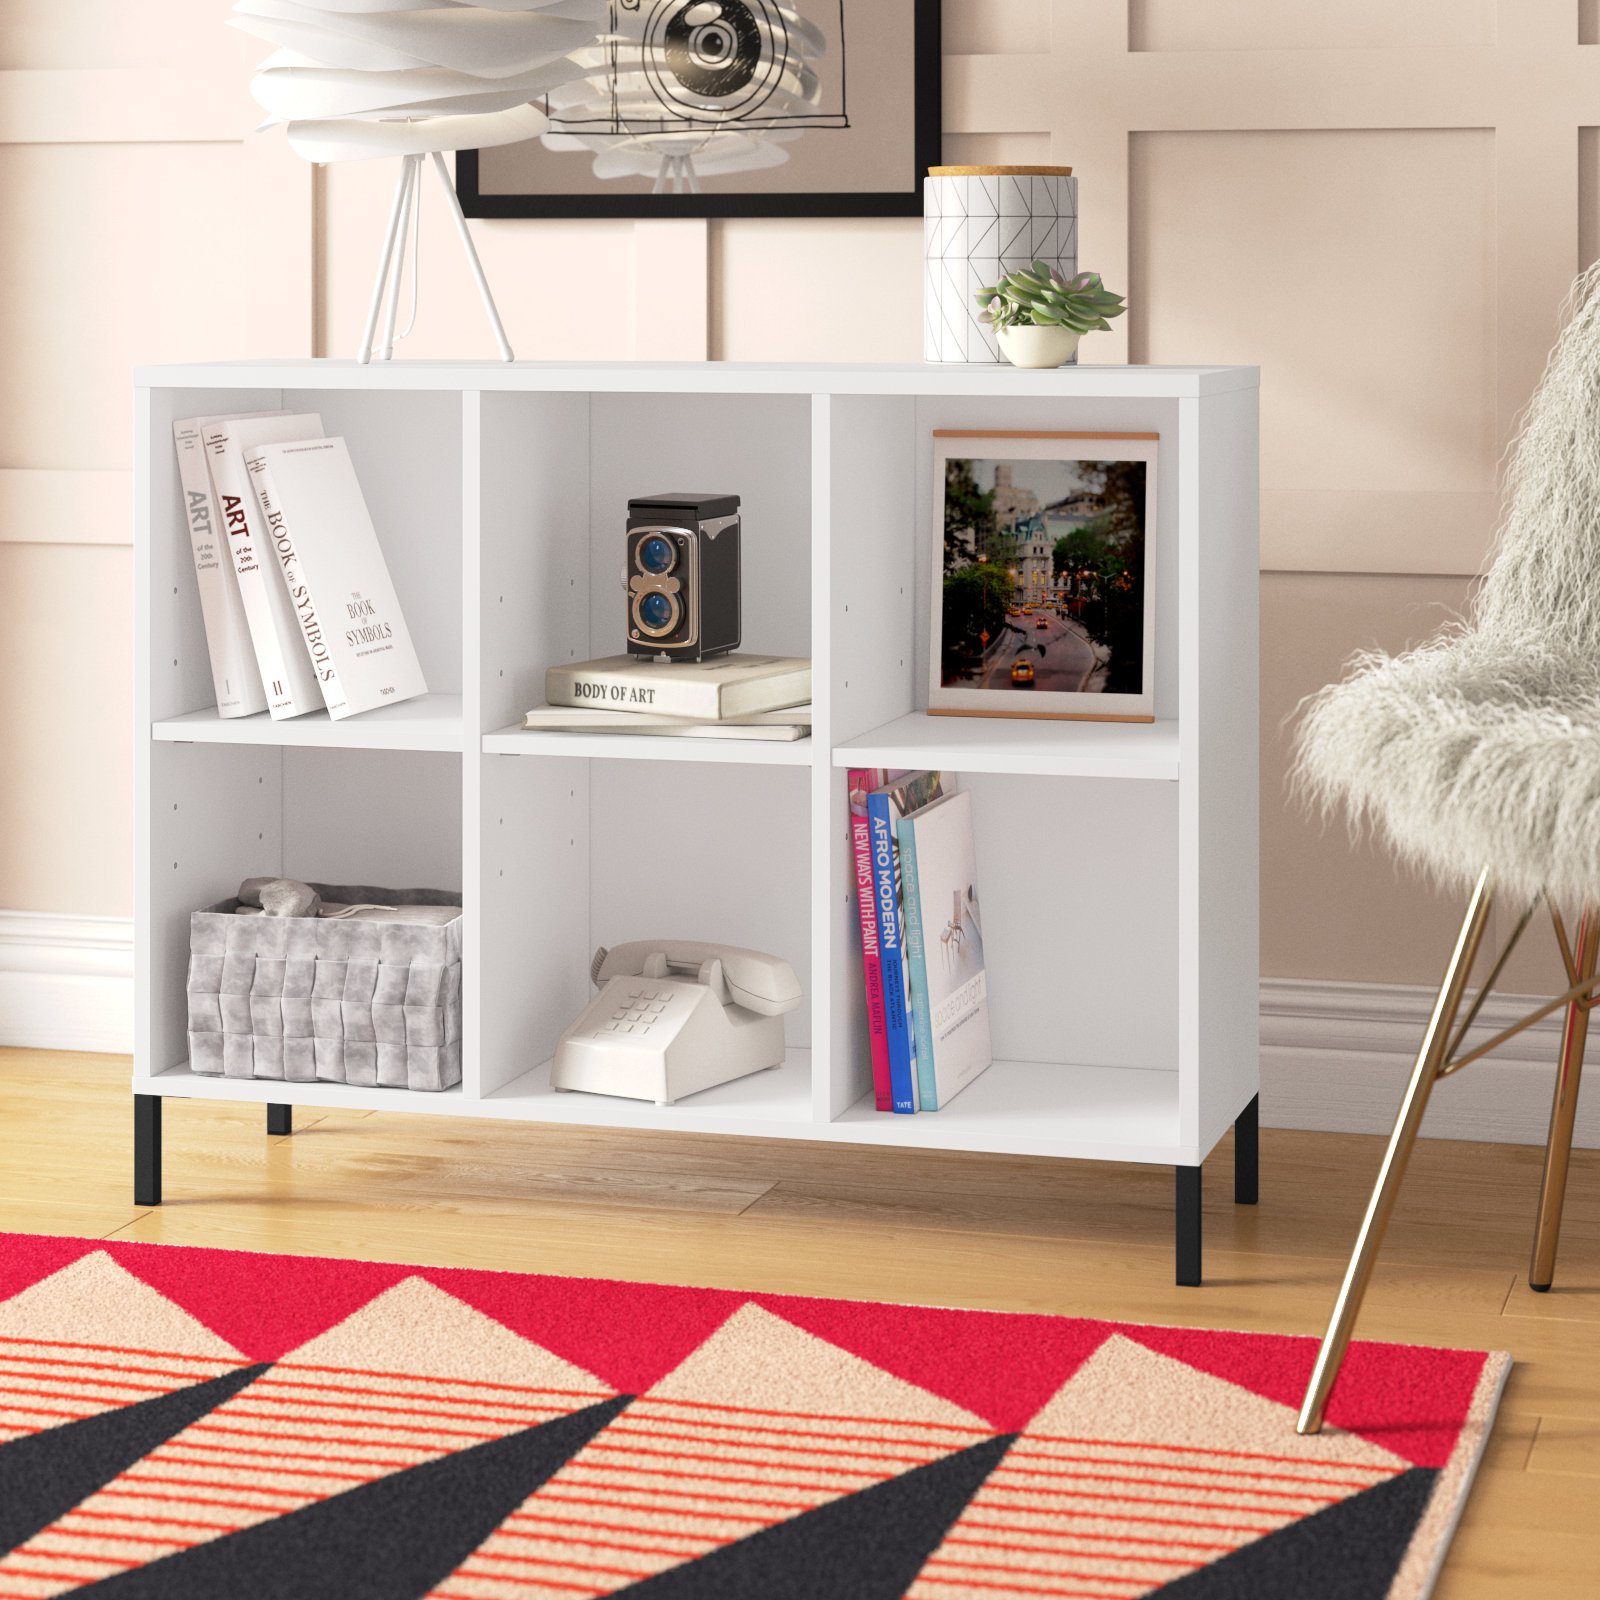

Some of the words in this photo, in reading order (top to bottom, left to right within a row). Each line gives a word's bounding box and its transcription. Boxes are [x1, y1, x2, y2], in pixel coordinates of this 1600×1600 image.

[187, 490, 212, 535] ART
[221, 495, 250, 537] ART
[198, 562, 219, 570] Century
[238, 565, 259, 573] Century
[260, 489, 272, 510] THE
[267, 510, 297, 568] BOOK
[287, 571, 296, 583] OF
[292, 585, 335, 682] SYMBOLS
[346, 599, 376, 619] BOOK
[345, 622, 393, 647] SYMBOLS
[574, 682, 608, 699] BODY
[610, 685, 627, 701] OF
[629, 687, 656, 704] ART
[853, 823, 869, 852] NEW
[873, 816, 889, 867] AFRO
[856, 852, 873, 885] WAYS
[902, 847, 914, 893] space
[860, 886, 875, 919] WITH
[878, 870, 897, 949] MODERN
[907, 897, 920, 928] and
[863, 921, 879, 957] PAINT
[909, 929, 923, 959] light
[868, 963, 879, 1000] ANDREA
[896, 1101, 912, 1109] TATE
